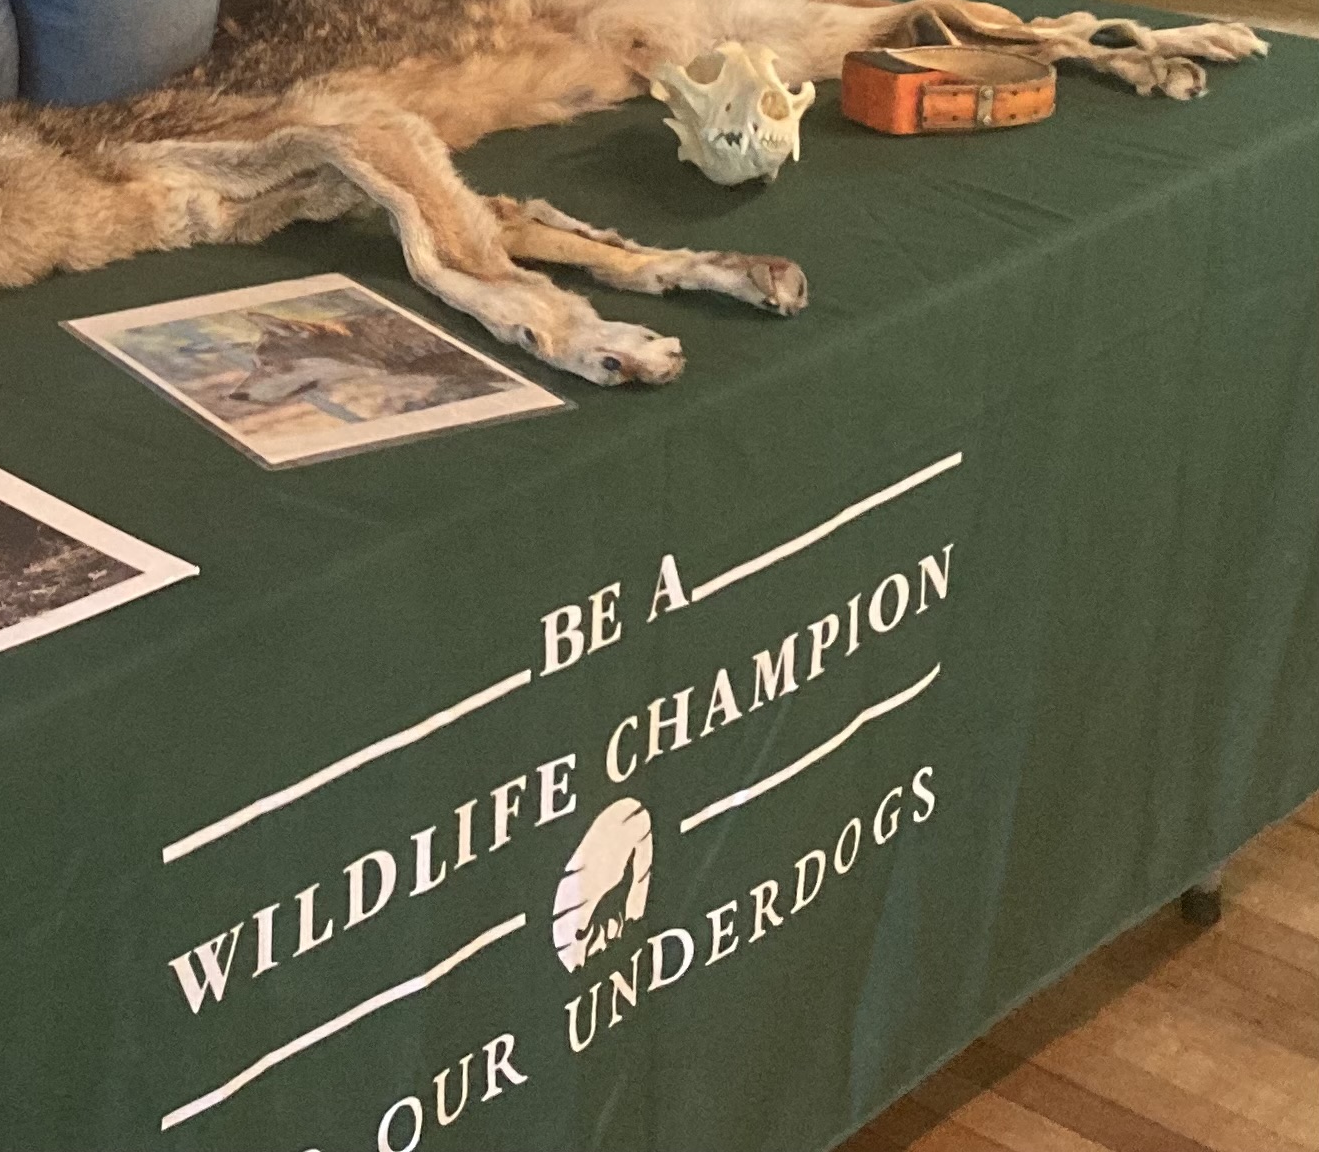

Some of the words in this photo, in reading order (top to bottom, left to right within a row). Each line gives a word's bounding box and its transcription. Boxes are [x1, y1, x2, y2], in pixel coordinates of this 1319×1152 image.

[167, 753, 577, 1015] WILDLIFE
[605, 543, 955, 784] CHAMPION
[540, 582, 622, 677] BE
[647, 553, 690, 623] A
[377, 1033, 529, 1152] OUR
[564, 765, 937, 1053] UNDERDOGS
